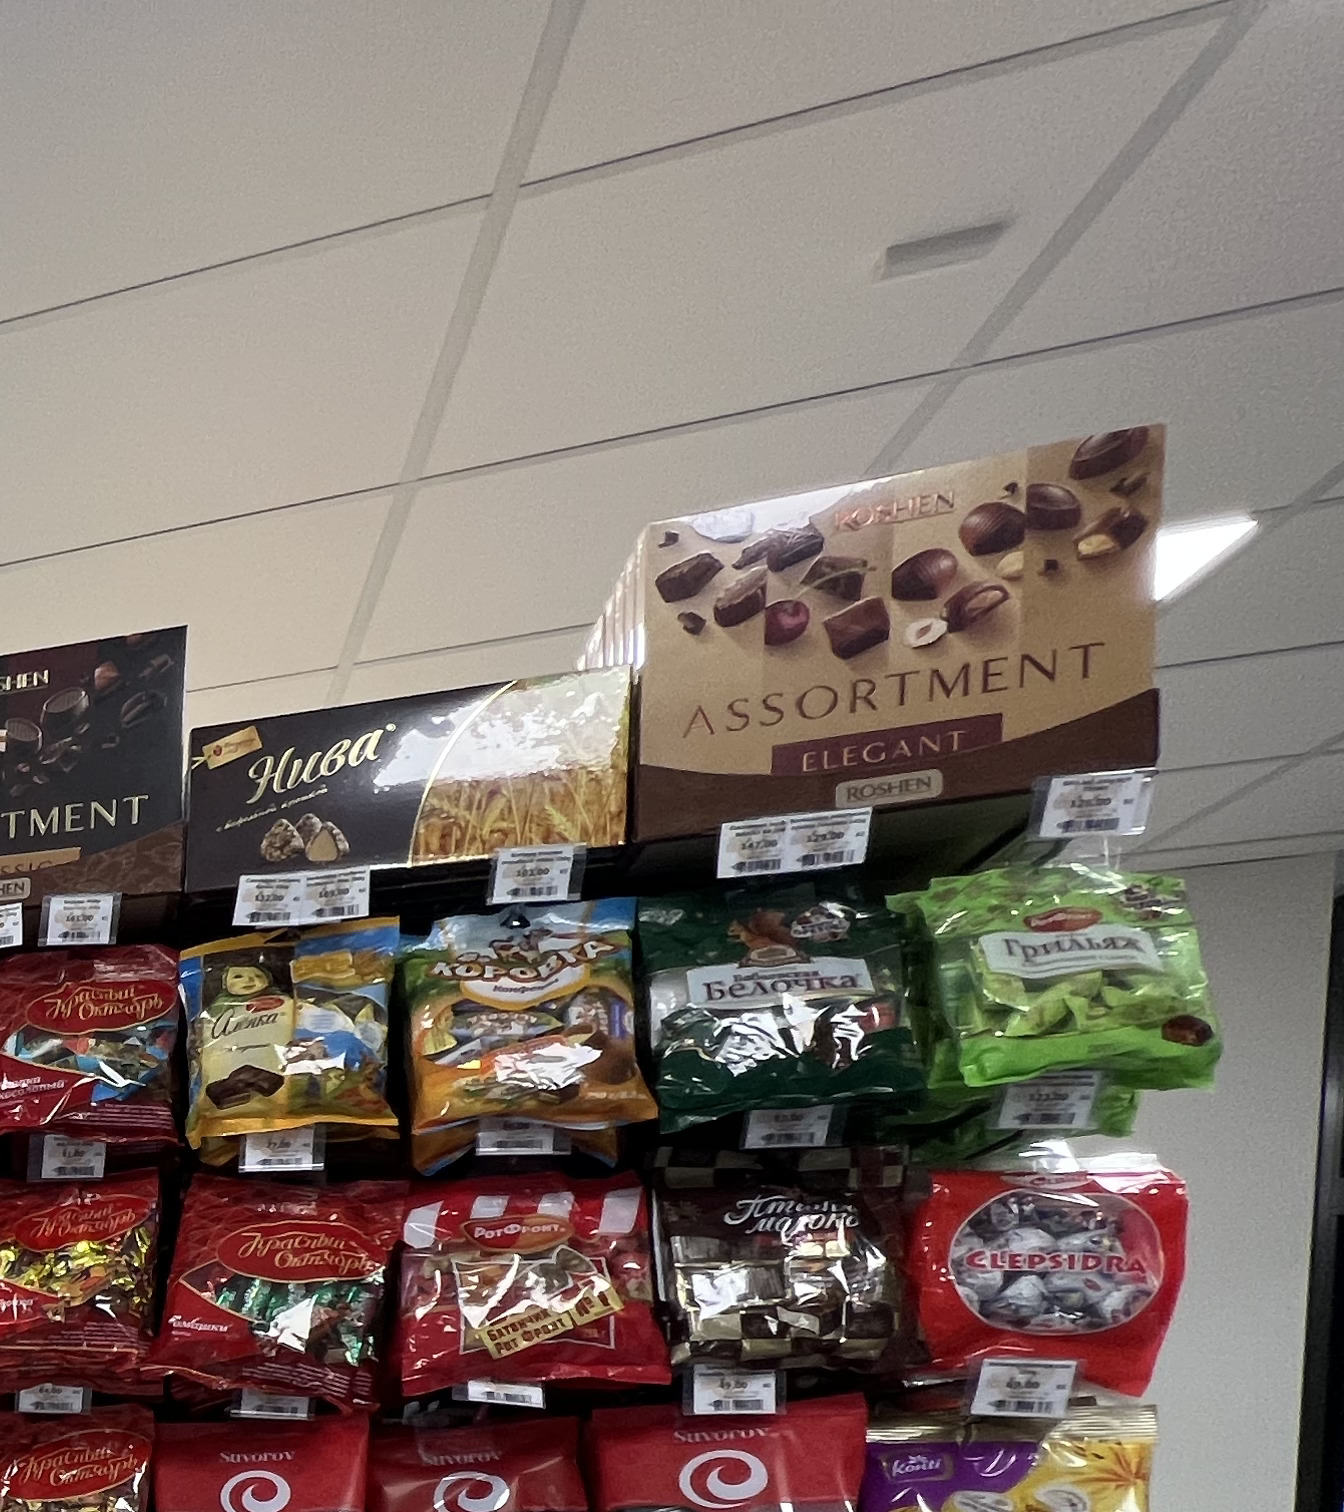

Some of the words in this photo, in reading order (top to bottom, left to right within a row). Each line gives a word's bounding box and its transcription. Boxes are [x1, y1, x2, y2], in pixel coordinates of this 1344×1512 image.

[834, 491, 955, 530] ROSHEN
[684, 642, 1106, 738] ASSORTMENT
[246, 726, 385, 804] Нива
[802, 729, 966, 773] ELEGANT
[846, 775, 934, 802] ROSHEN
[431, 940, 615, 981] КОРОВКА
[1004, 933, 1146, 963] Грильяж
[702, 973, 860, 1001] Белочка
[78, 993, 164, 1019] Октябрь
[239, 1232, 353, 1259] Красный
[965, 1249, 1147, 1277] CLEPSIDRA
[21, 1447, 114, 1481] Красный
[219, 1450, 296, 1465] Suvorov
